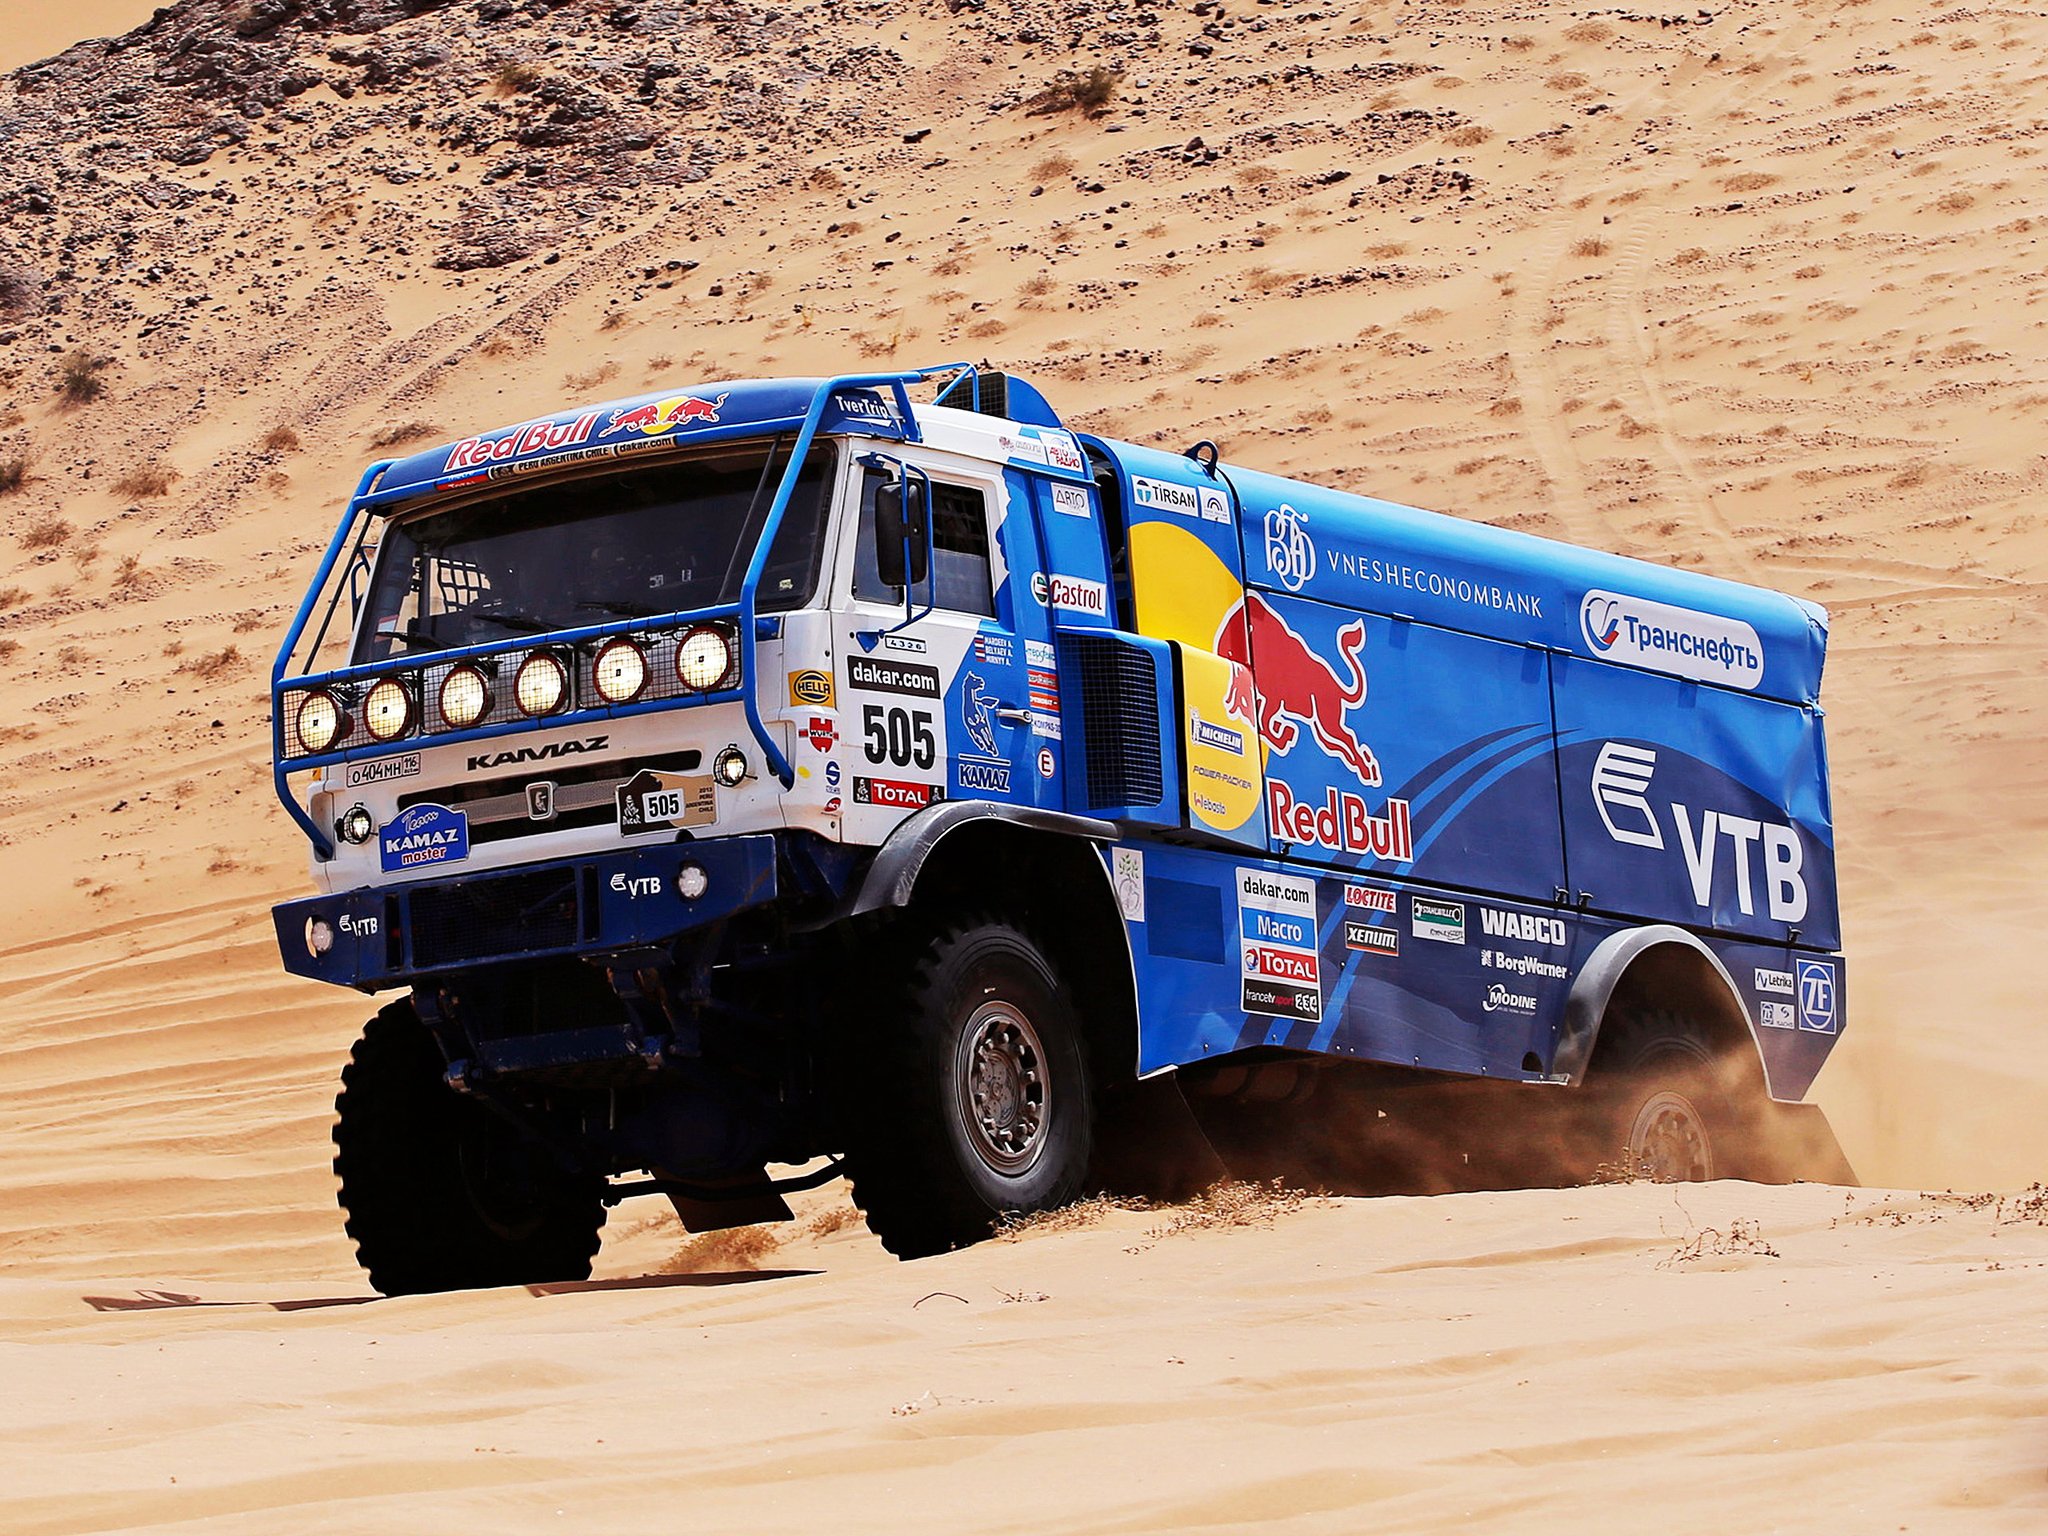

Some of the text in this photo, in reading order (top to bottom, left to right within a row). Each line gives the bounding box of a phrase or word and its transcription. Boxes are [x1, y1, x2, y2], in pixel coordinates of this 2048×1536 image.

[443, 410, 604, 472] Red Bull
[619, 438, 672, 452] dakar.com
[518, 447, 609, 472] PERU ARGENTINA CHILE
[1050, 579, 1102, 611] Castrol
[1327, 550, 1543, 618] VNESHECONOMBANK
[890, 640, 922, 650] 4326
[1623, 615, 1758, 670] Транснефть
[798, 681, 830, 695] HELLA
[853, 662, 936, 691] dakar.com
[862, 704, 936, 770] 505
[1201, 728, 1241, 750] MICHELIN
[404, 756, 417, 768] 116
[467, 735, 609, 771] KAMAZ
[1041, 754, 1051, 773] E
[959, 764, 1010, 793] KAMAZ
[1192, 765, 1252, 790] POWER-PACKER
[648, 794, 680, 817] 505
[1193, 792, 1226, 815] Webasto
[402, 810, 439, 834] Team
[1266, 777, 1414, 863] Red Bull
[386, 829, 459, 853] KAMAZ
[402, 847, 446, 866] master
[1671, 803, 1808, 923] VTB
[628, 876, 661, 896] VTB
[1244, 876, 1310, 904] dakar.com
[1346, 887, 1395, 911] LOCTITE
[352, 916, 378, 937] VTB
[1257, 915, 1302, 942] Macro
[1480, 907, 1566, 946] WABCO
[1496, 951, 1568, 979] BorgWarner
[1489, 991, 1537, 1010] MODINE
[1803, 977, 1831, 1017] ZF
